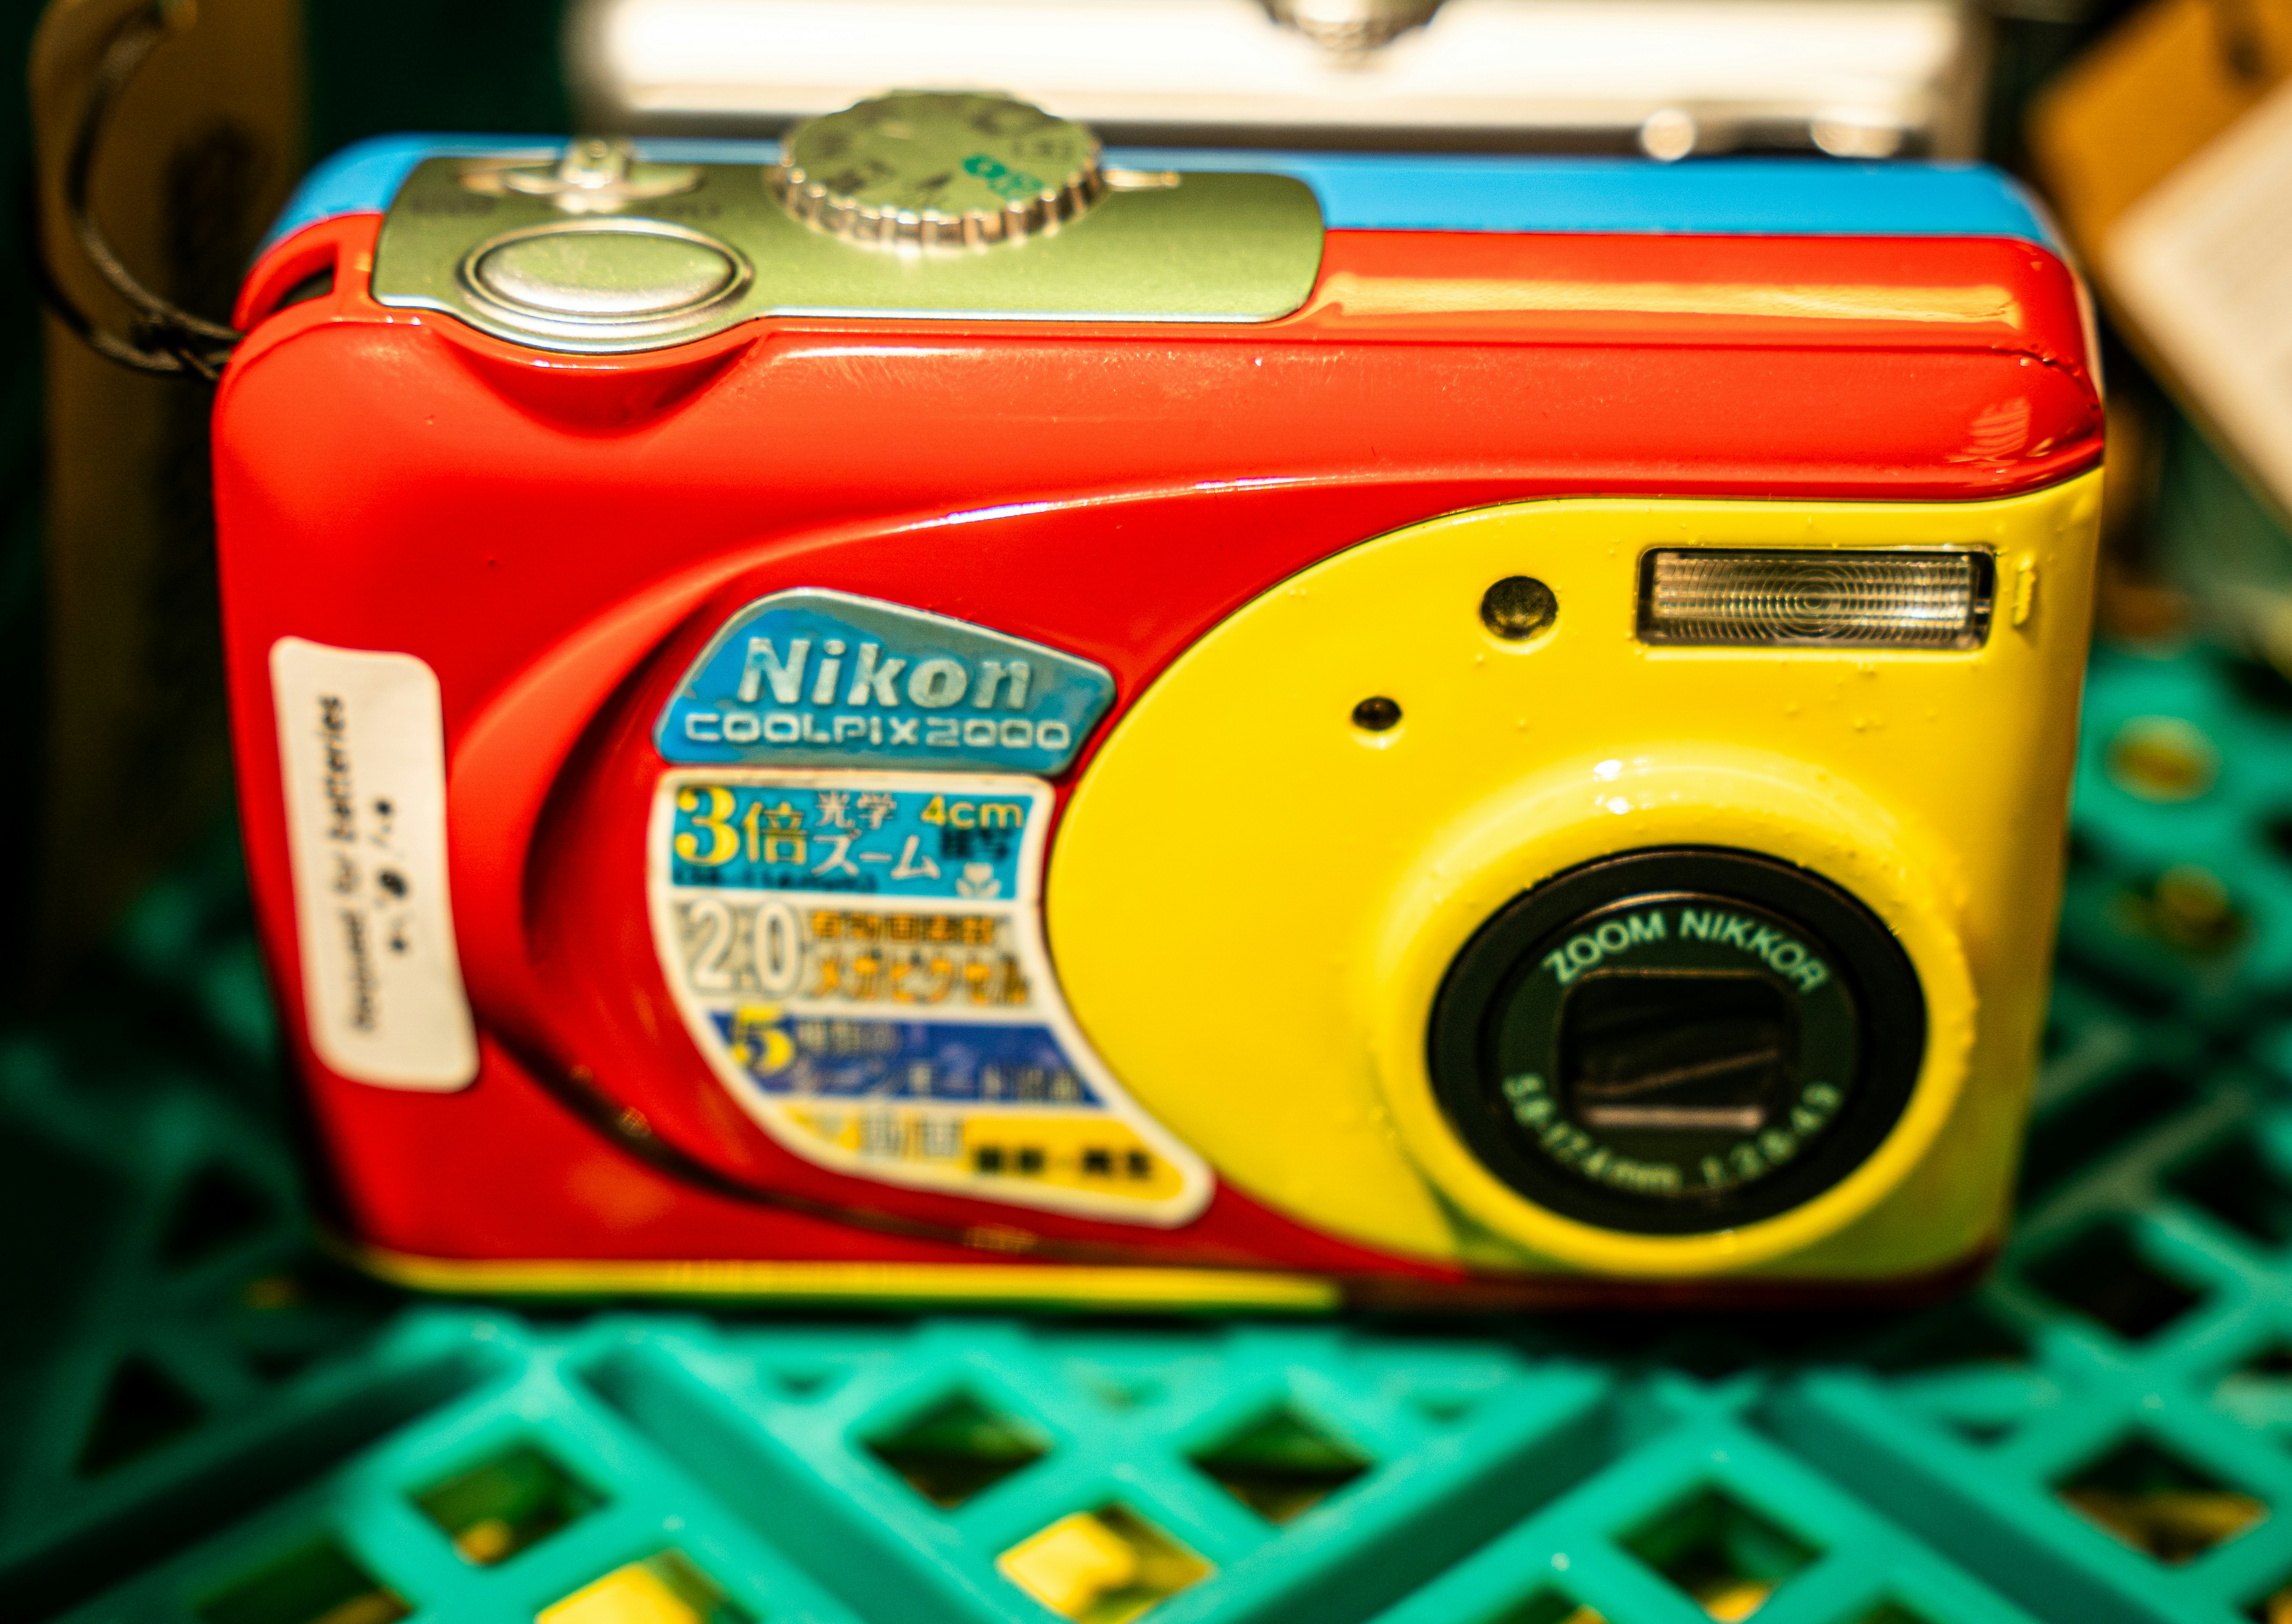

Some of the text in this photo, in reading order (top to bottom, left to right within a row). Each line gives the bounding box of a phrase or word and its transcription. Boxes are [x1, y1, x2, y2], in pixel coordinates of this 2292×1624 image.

[737, 636, 1031, 710] Nikon
[316, 694, 356, 843] batteries
[815, 791, 897, 829] 光学
[921, 795, 1024, 830] 4cm
[811, 830, 941, 879] ズーム
[688, 898, 800, 993] 2.0
[1541, 908, 1831, 995] ZOOM NIKKOR
[730, 1002, 795, 1076] 5
